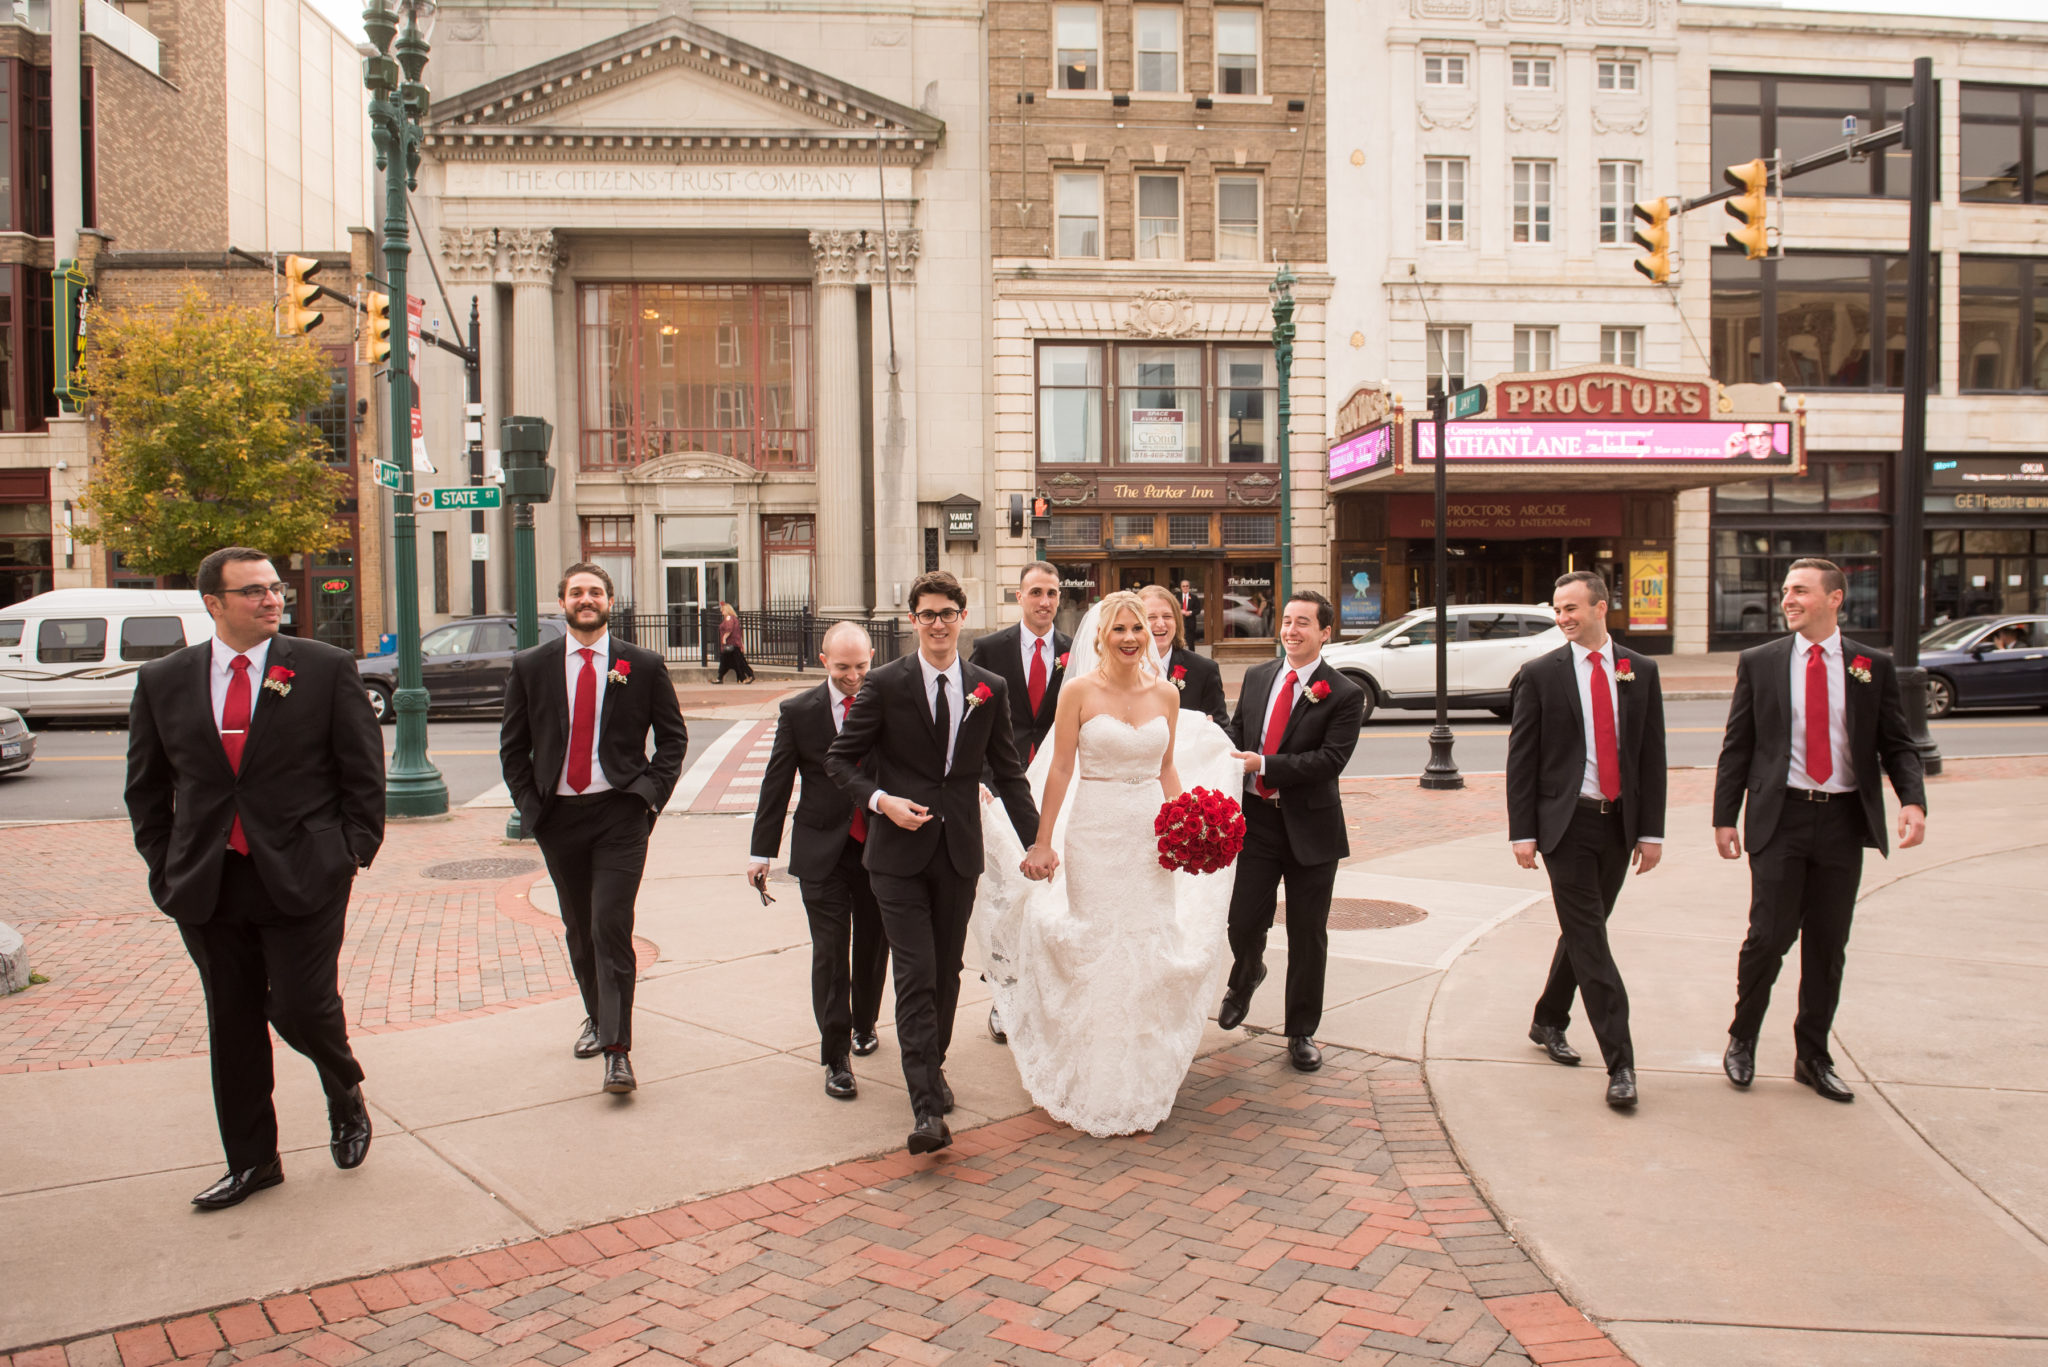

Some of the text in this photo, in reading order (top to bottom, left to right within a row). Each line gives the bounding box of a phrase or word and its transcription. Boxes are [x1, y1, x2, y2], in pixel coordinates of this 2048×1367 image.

[503, 169, 857, 193] THE CITIZENS TRUST COMPANY
[1505, 378, 1703, 415] PROCTOR'S
[1511, 426, 1533, 436] with
[1521, 436, 1582, 456] LANE
[382, 468, 396, 483] JAY
[1113, 484, 1215, 498] The Parker Inn
[441, 490, 495, 506] STATE ST
[1955, 493, 1974, 509] GE
[1975, 493, 2025, 509] Theatre
[949, 512, 973, 521] VAULT
[1447, 504, 1567, 516] PROCTORS ARCADE
[949, 521, 974, 530] ALARM
[1421, 519, 1436, 528] FIN
[1495, 518, 1516, 528] AND
[1520, 517, 1593, 528] ENTERTAINMENT
[1064, 578, 1084, 587] Parker
[1084, 578, 1096, 587] Inn
[1228, 577, 1271, 585] The Parker Inn
[1633, 579, 1663, 597] FUN
[1633, 598, 1663, 609] HOME
